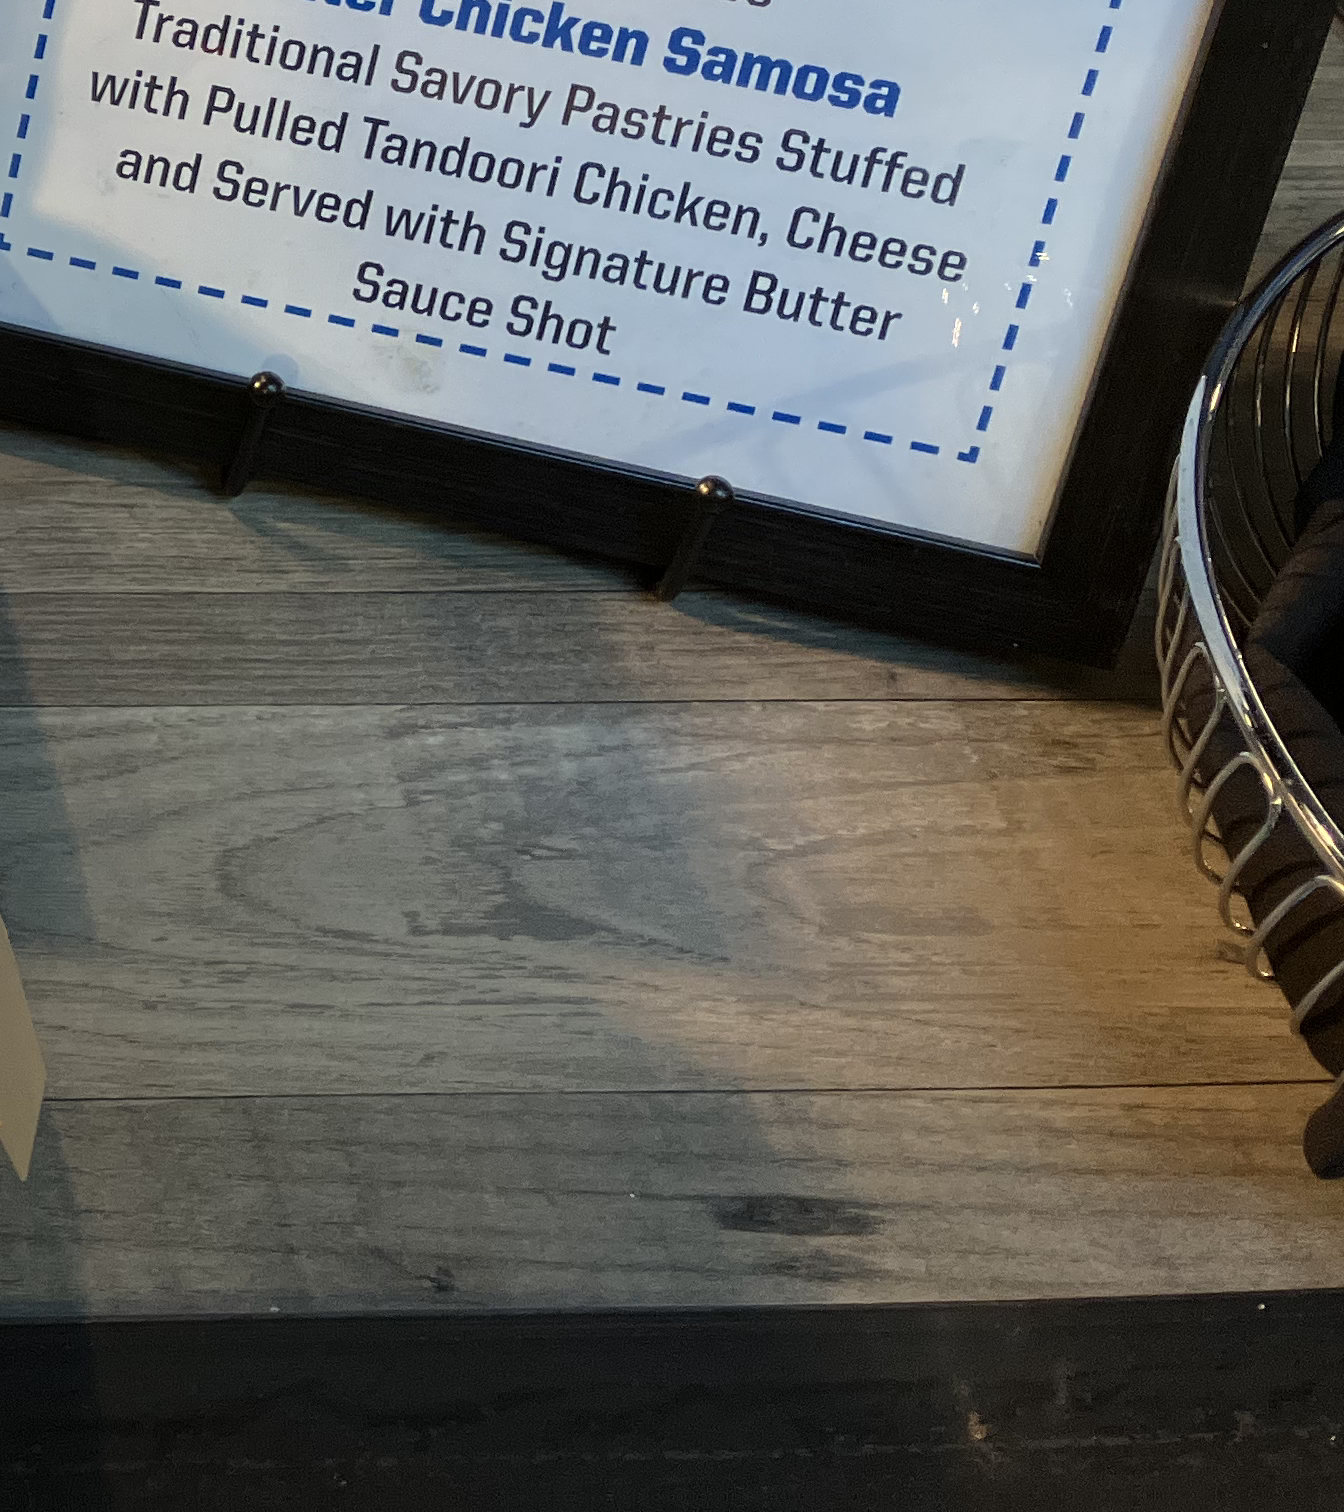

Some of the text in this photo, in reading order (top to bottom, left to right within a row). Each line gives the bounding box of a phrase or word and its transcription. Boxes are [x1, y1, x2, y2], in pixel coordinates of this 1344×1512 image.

[390, 49, 553, 129] Savory
[561, 82, 764, 164] Pastries
[775, 128, 966, 207] Stuffed
[662, 26, 902, 119] Samosa
[90, 69, 968, 283] with Pulled Tandoori Chicken, Cheese
[115, 148, 904, 341] and Served with Signature Butter
[352, 260, 617, 356] Sauce Shot
